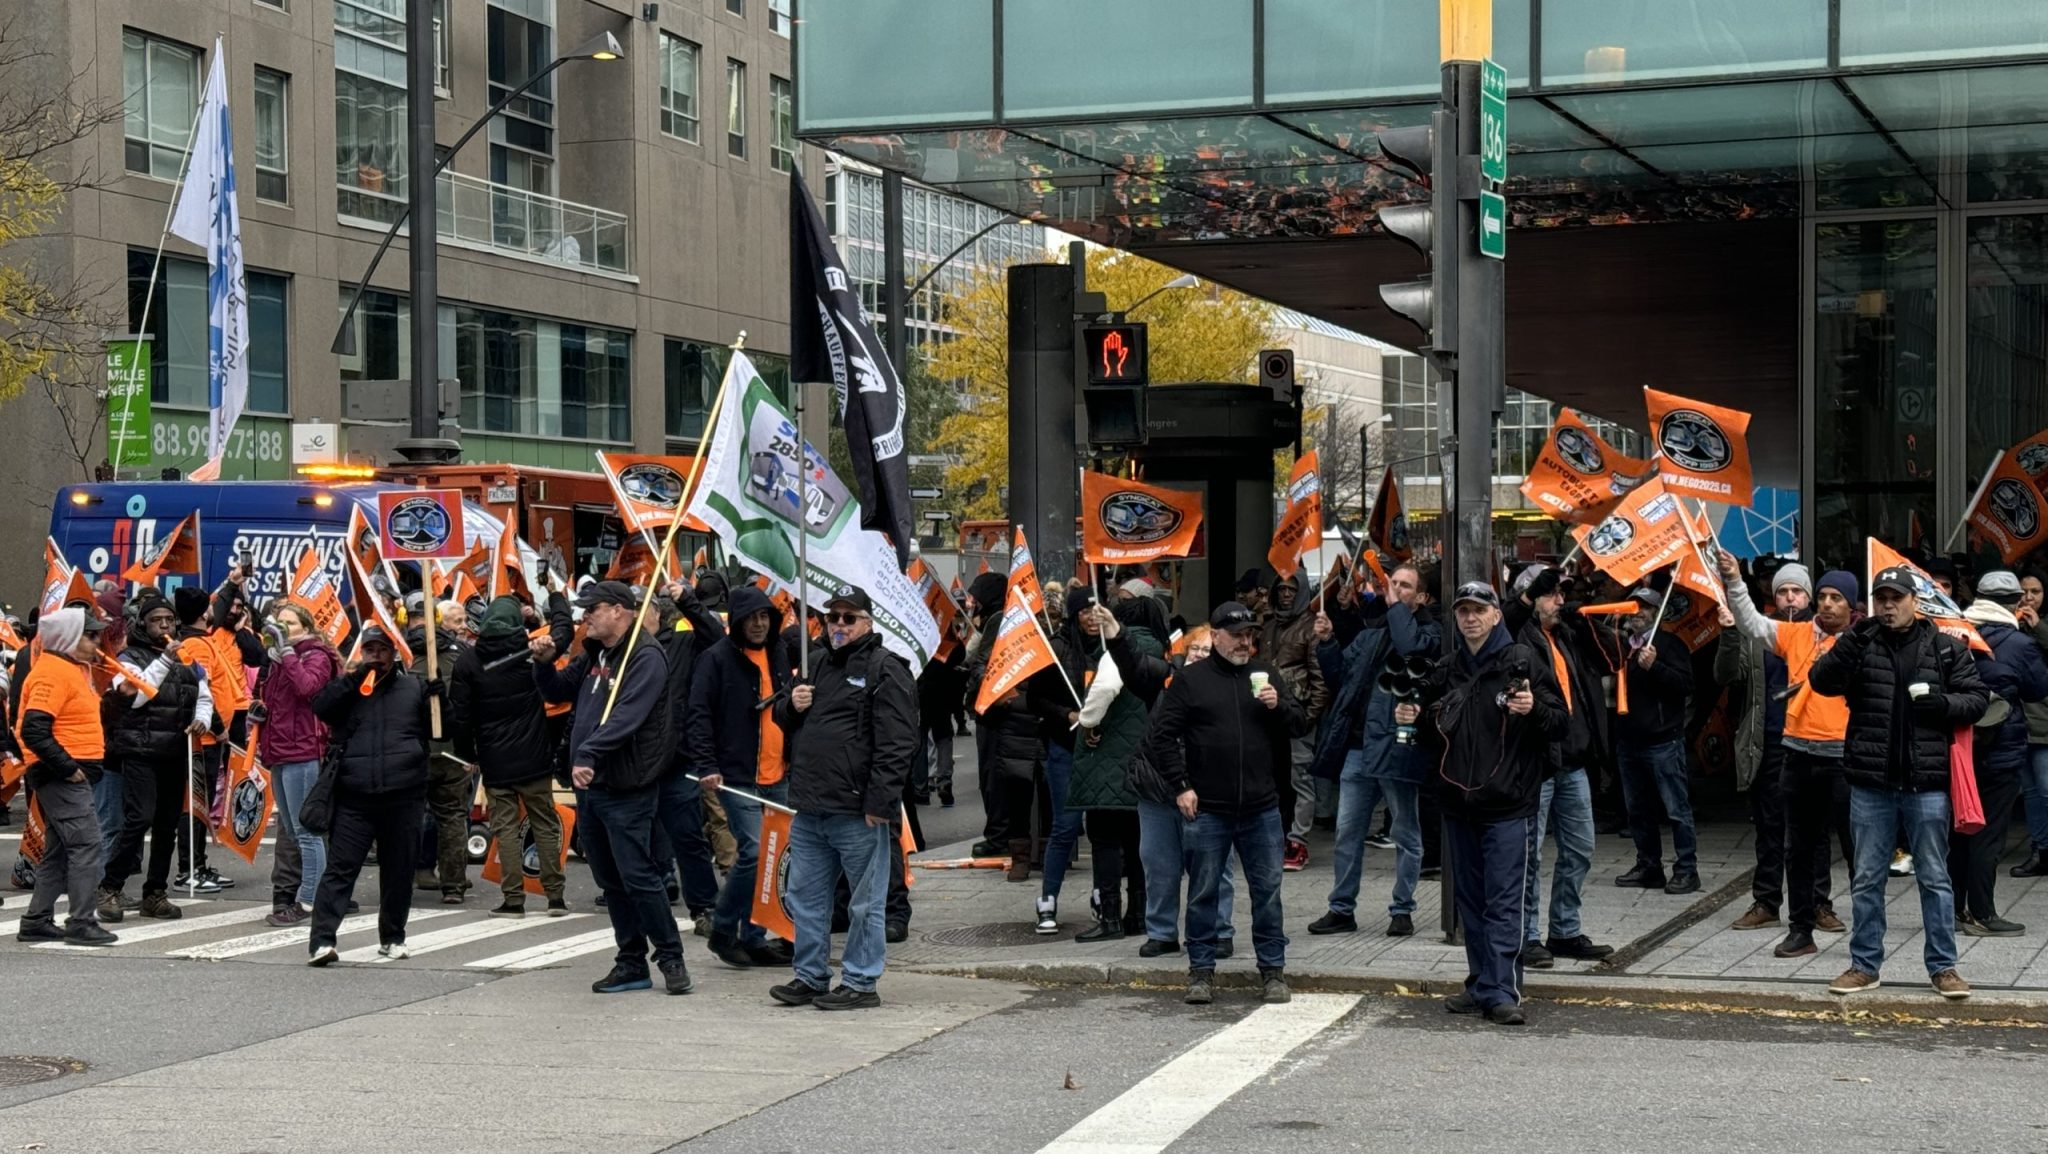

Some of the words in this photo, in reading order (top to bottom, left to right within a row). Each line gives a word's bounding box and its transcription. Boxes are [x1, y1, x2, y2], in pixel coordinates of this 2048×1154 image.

[1483, 111, 1503, 163] 136
[107, 355, 122, 366] LE
[107, 369, 146, 381] MILLE
[107, 384, 144, 396] NEUF
[1147, 418, 1178, 430] ngrès
[153, 423, 283, 462] 88.99.7388
[1118, 495, 1162, 508] SYNDICAT
[228, 535, 346, 571] SAUVONS
